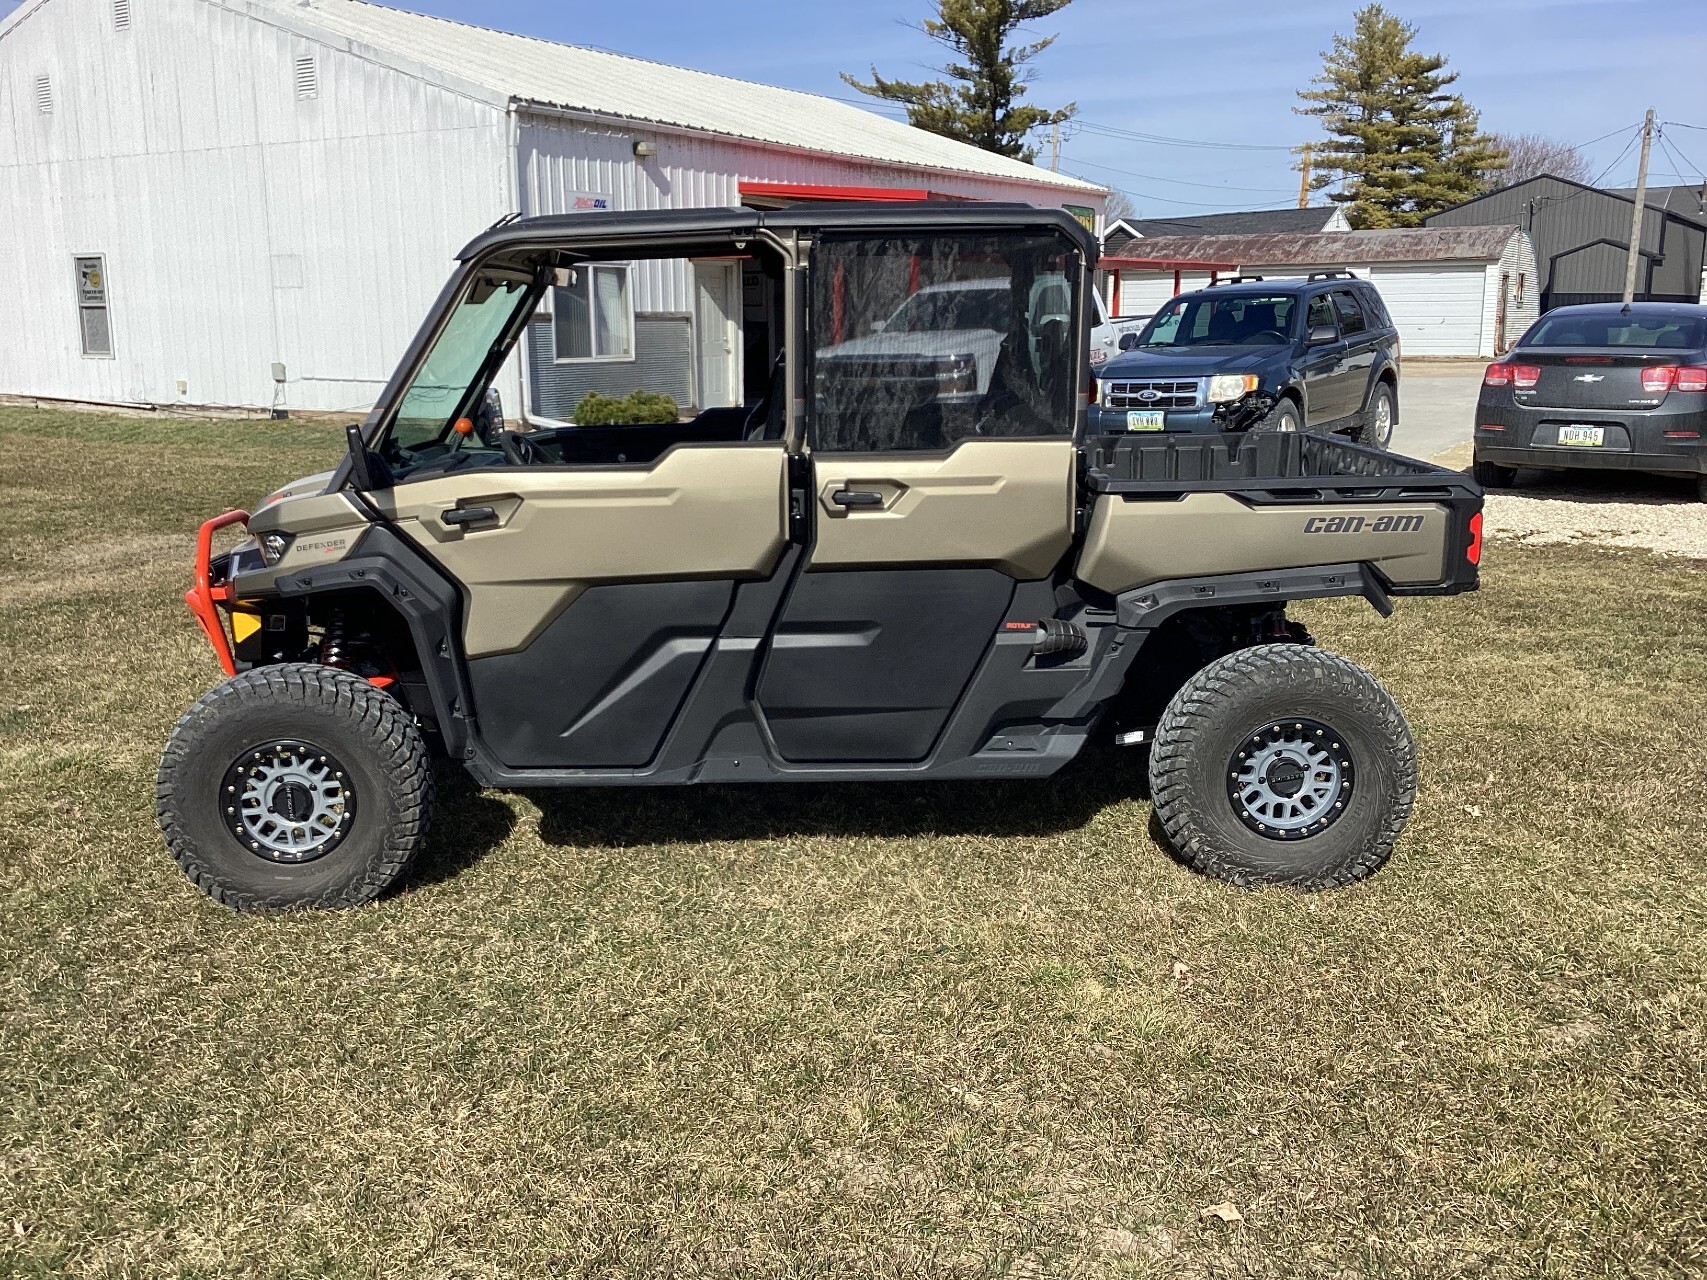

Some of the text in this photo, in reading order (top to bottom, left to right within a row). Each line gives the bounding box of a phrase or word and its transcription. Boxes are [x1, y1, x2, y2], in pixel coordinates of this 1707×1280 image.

[1563, 430, 1599, 441] NDH 945
[1303, 515, 1425, 534] can-am
[296, 539, 347, 552] DEFENDER
